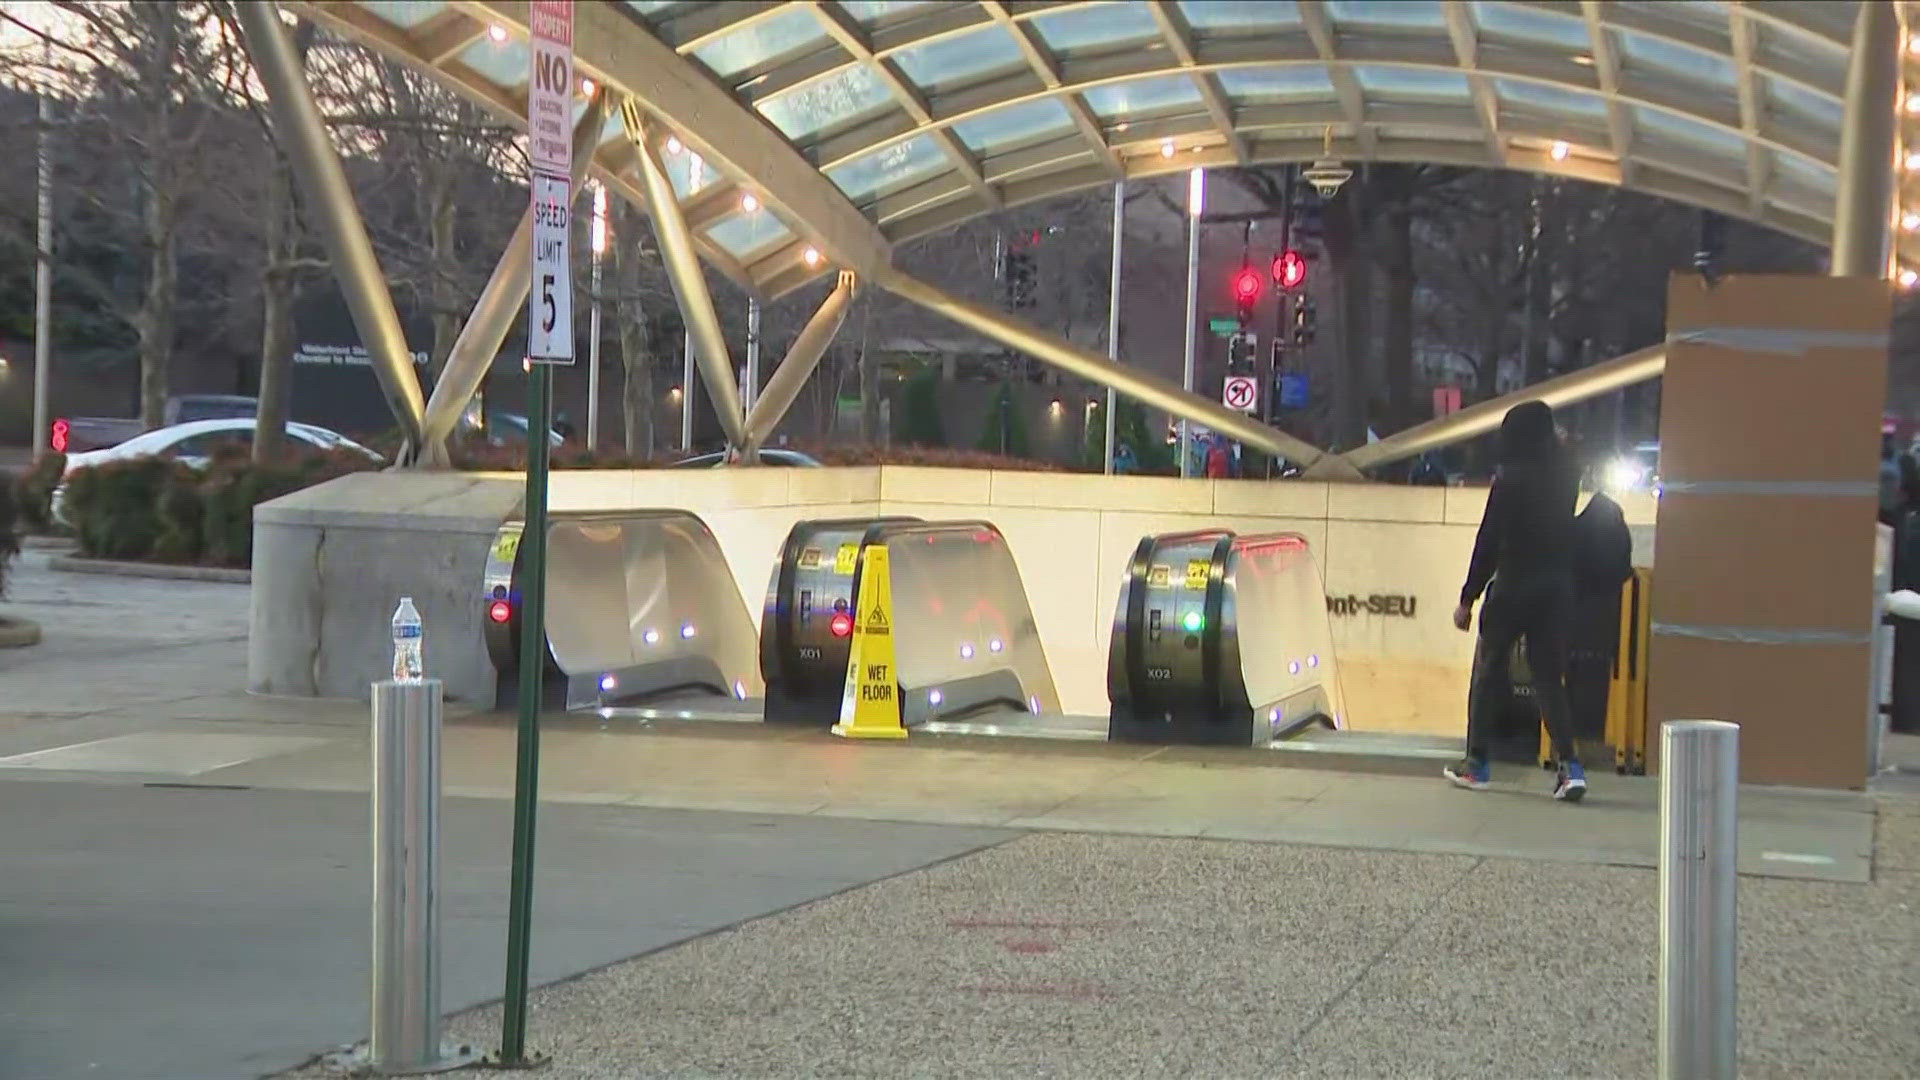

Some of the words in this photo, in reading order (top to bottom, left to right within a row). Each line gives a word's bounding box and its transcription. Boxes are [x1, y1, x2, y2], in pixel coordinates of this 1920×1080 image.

[533, 8, 570, 45] PROPERTY
[536, 49, 567, 96] NO
[535, 201, 567, 229] SPEED
[538, 240, 562, 265] LIMIT
[542, 274, 556, 333] 5
[800, 648, 821, 658] X01
[868, 664, 887, 680] WET
[1147, 668, 1171, 679] X02
[862, 685, 891, 701] FLOOR
